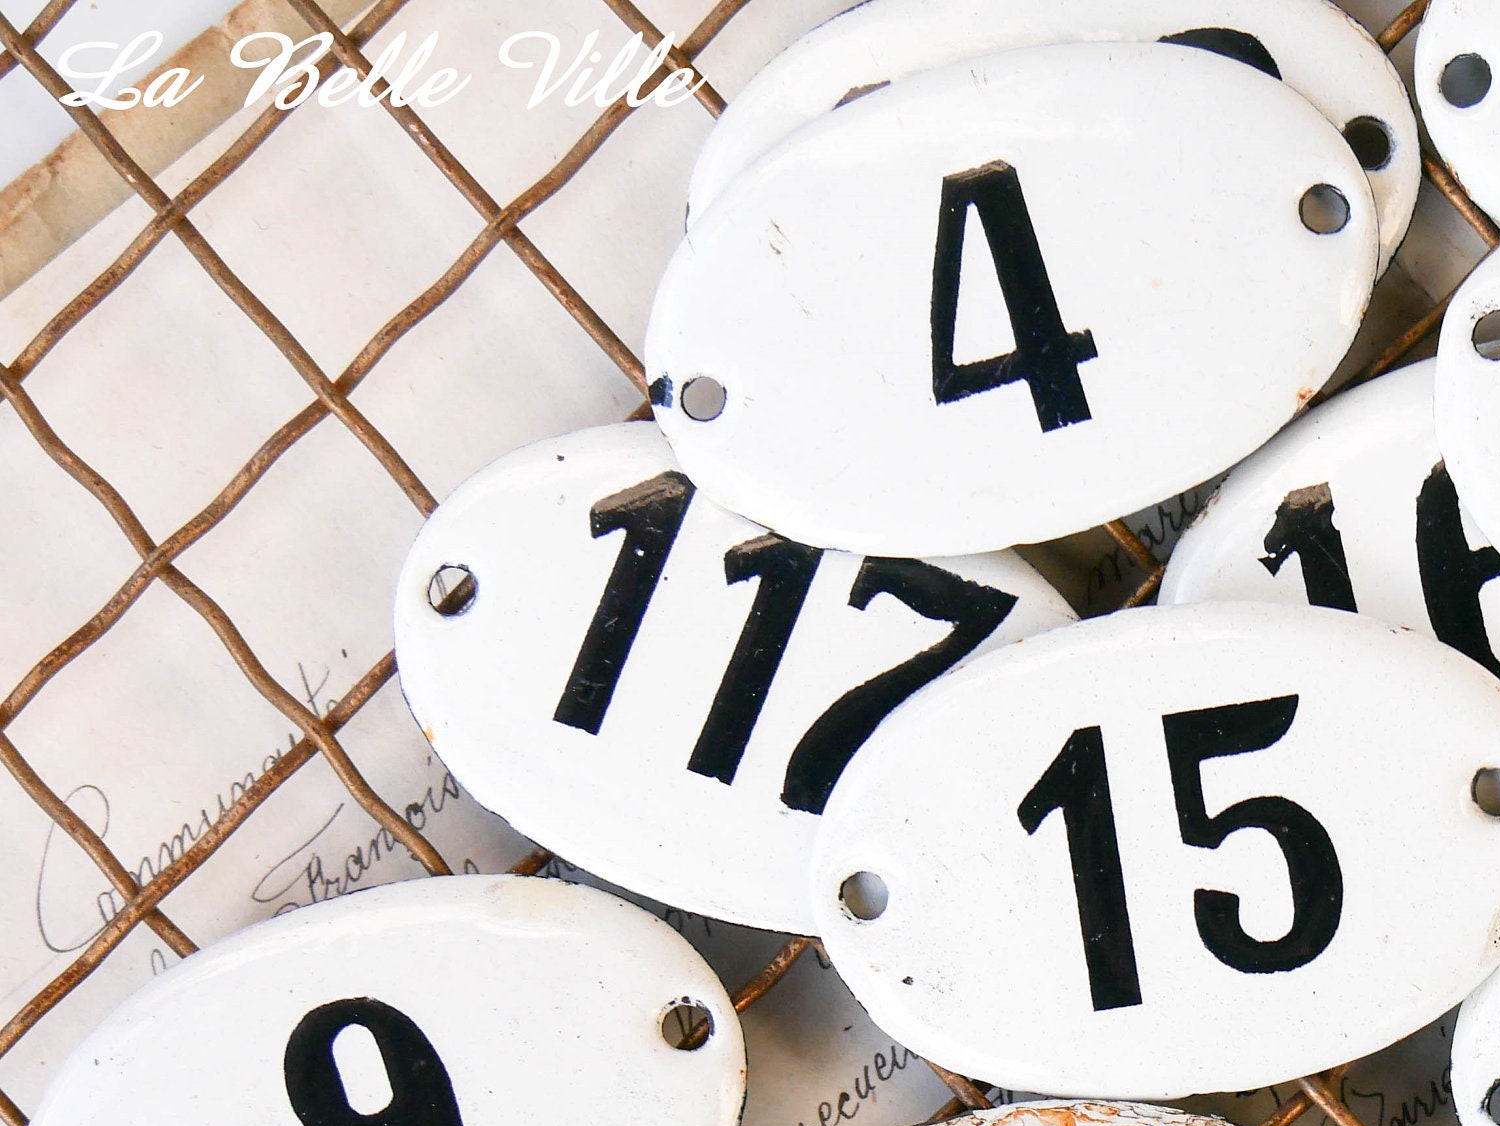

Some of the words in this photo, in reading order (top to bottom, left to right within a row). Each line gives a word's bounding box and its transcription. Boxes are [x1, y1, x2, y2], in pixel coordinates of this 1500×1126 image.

[931, 159, 1098, 433] 4
[553, 469, 1019, 815] 117
[1018, 694, 1344, 1012] 15
